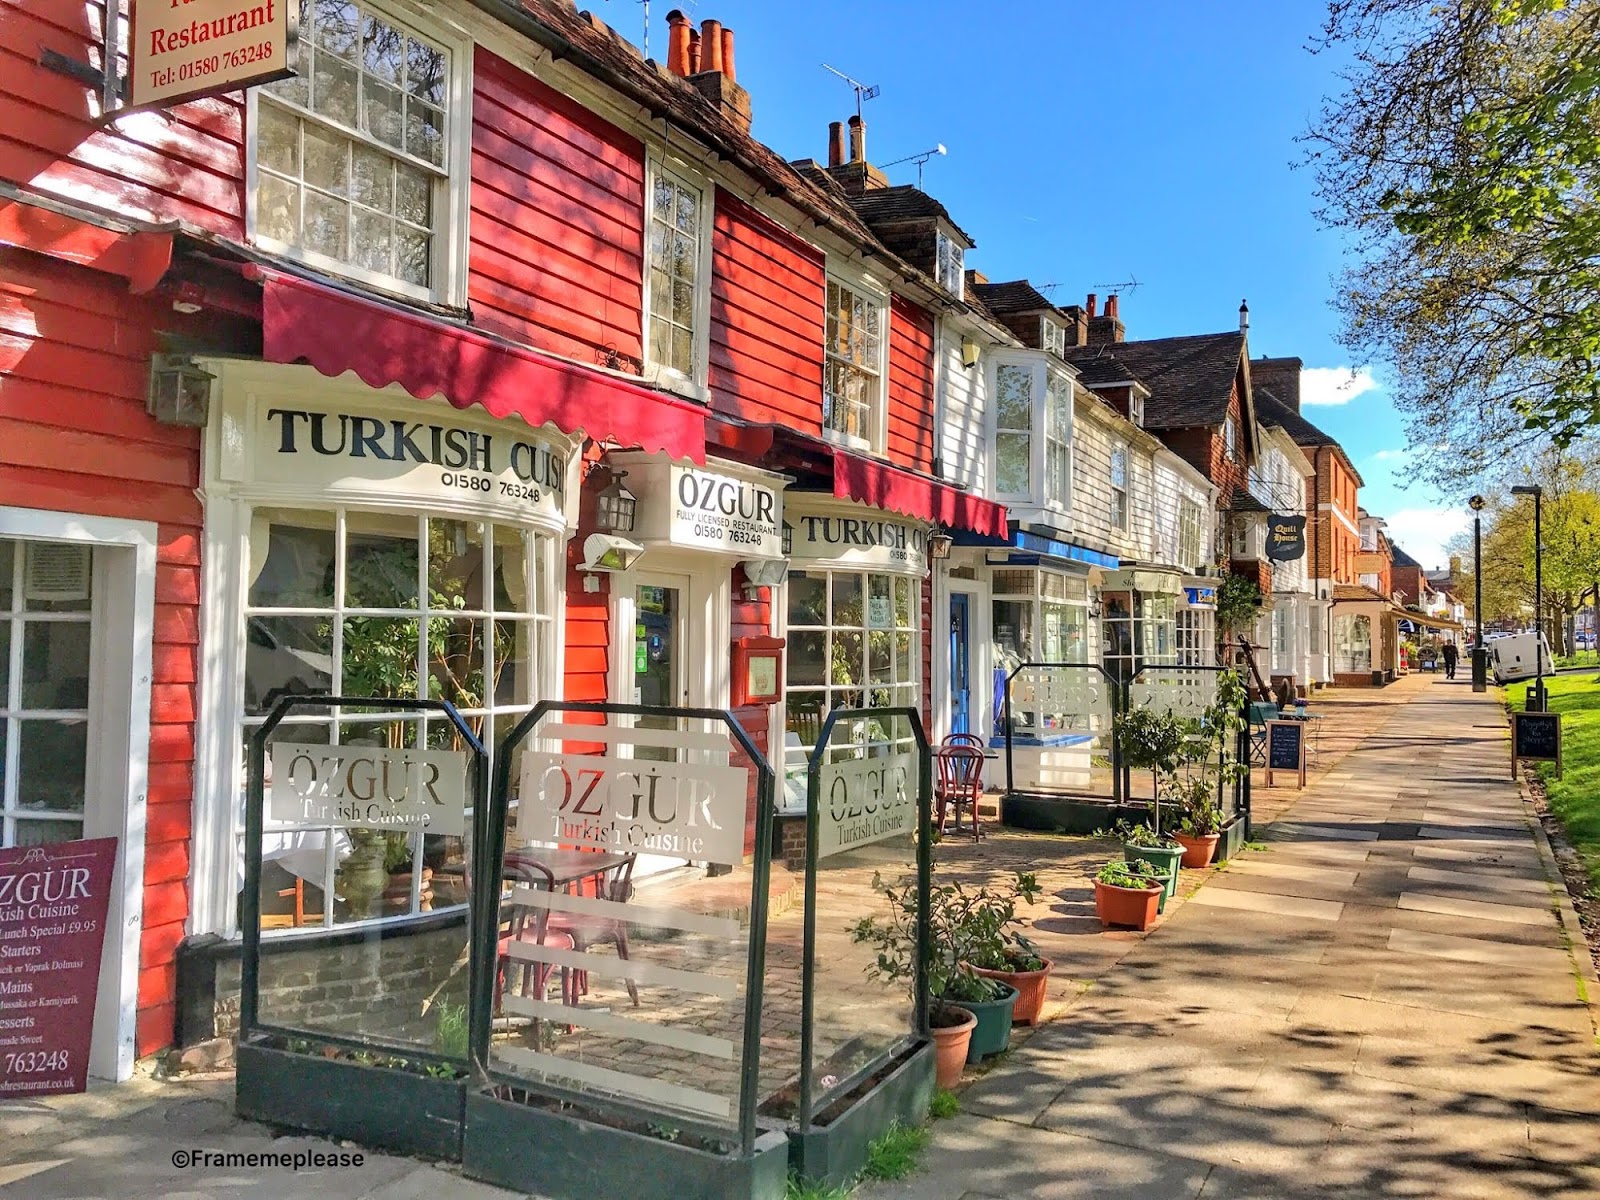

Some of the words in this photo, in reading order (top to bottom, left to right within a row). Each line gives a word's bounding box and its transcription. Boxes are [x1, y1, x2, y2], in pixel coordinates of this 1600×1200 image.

[150, 0, 275, 56] Restaurant
[151, 67, 175, 88] Tel:
[179, 55, 219, 82] 01580
[222, 41, 273, 70] 763248
[267, 408, 493, 473] TURKISH
[441, 472, 491, 492] 01580
[499, 481, 540, 502] 763248
[676, 510, 696, 522] FULLY
[697, 513, 731, 528] LICENSED
[732, 520, 777, 536] RESTAURANT
[694, 524, 723, 540] 01580
[728, 531, 762, 546] 763248
[801, 515, 906, 550] TURKISH
[1274, 524, 1297, 535] Quill
[1273, 533, 1298, 546] House
[288, 748, 446, 806] ÖZGÜR
[837, 818, 871, 846] Turkish
[872, 811, 903, 836] Cuisine
[28, 901, 80, 919] Cuisine
[29, 922, 66, 940] Special
[67, 919, 97, 935] £9.95
[0, 944, 42, 959] Starters
[0, 980, 33, 995] Mains
[20, 1034, 44, 1045] Sweet
[5, 1049, 70, 1074] 763248
